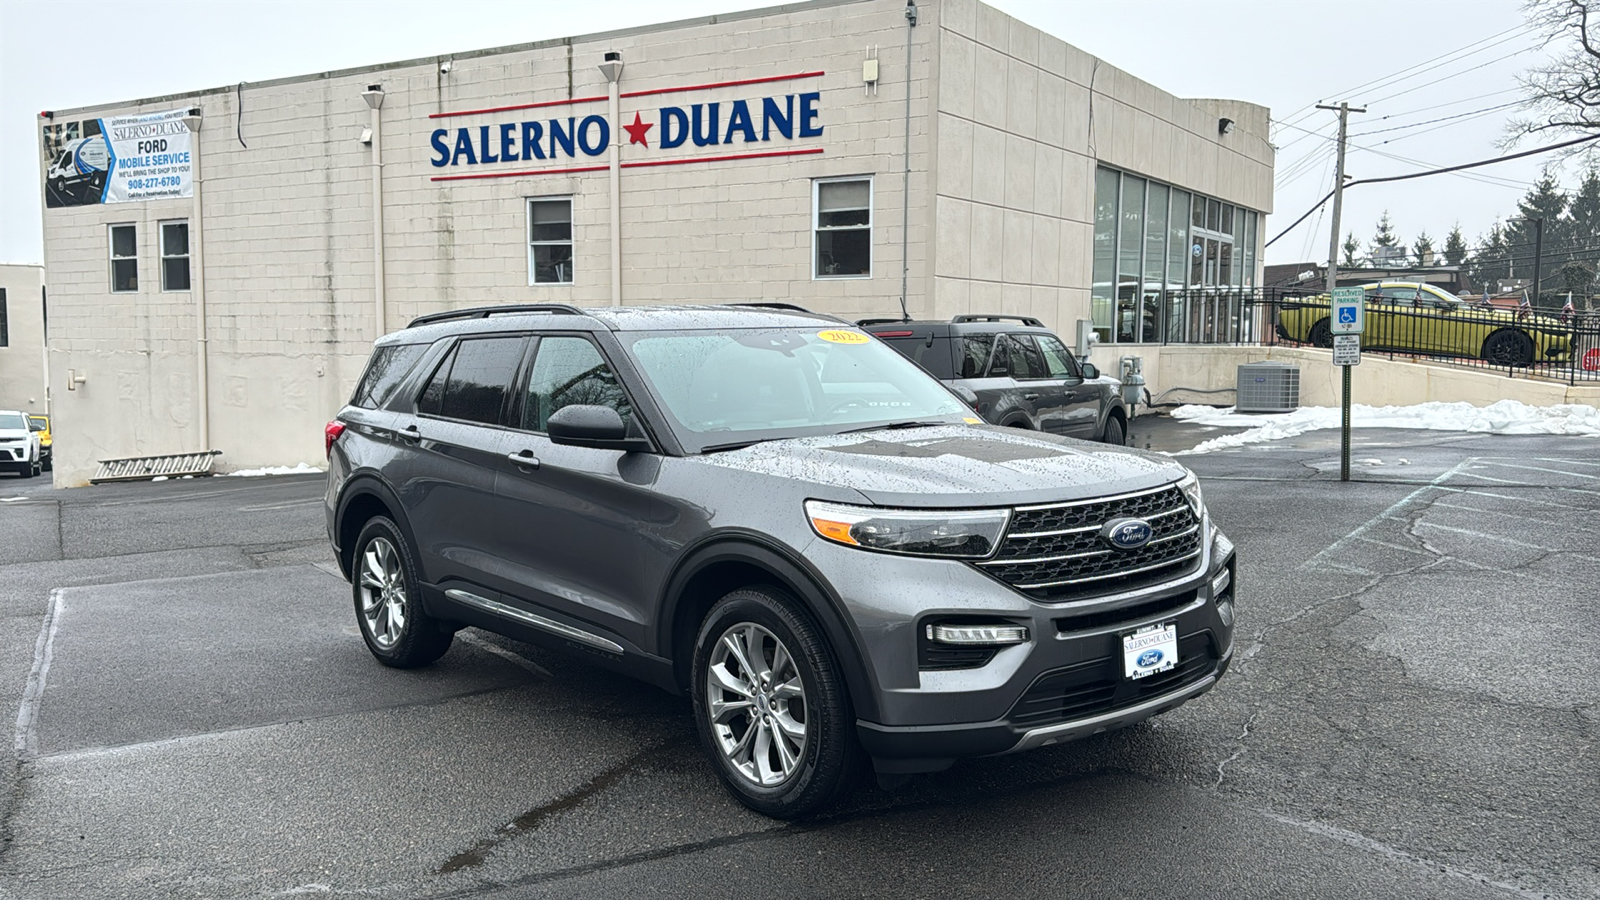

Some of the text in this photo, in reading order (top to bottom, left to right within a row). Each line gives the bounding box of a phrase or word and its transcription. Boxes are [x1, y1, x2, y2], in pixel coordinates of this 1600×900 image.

[114, 122, 187, 139] SALERNO DUANE
[430, 91, 825, 167] SALERNO DUANE
[138, 139, 168, 154] FORD
[119, 152, 190, 169] MOBILE SERVICE
[133, 169, 147, 177] BRING
[127, 175, 181, 189] 908-277-6780
[827, 332, 862, 341] 2022
[1122, 525, 1146, 542] Ford
[1125, 631, 1174, 651] SALERNO DUANE
[1141, 652, 1159, 666] Ford
